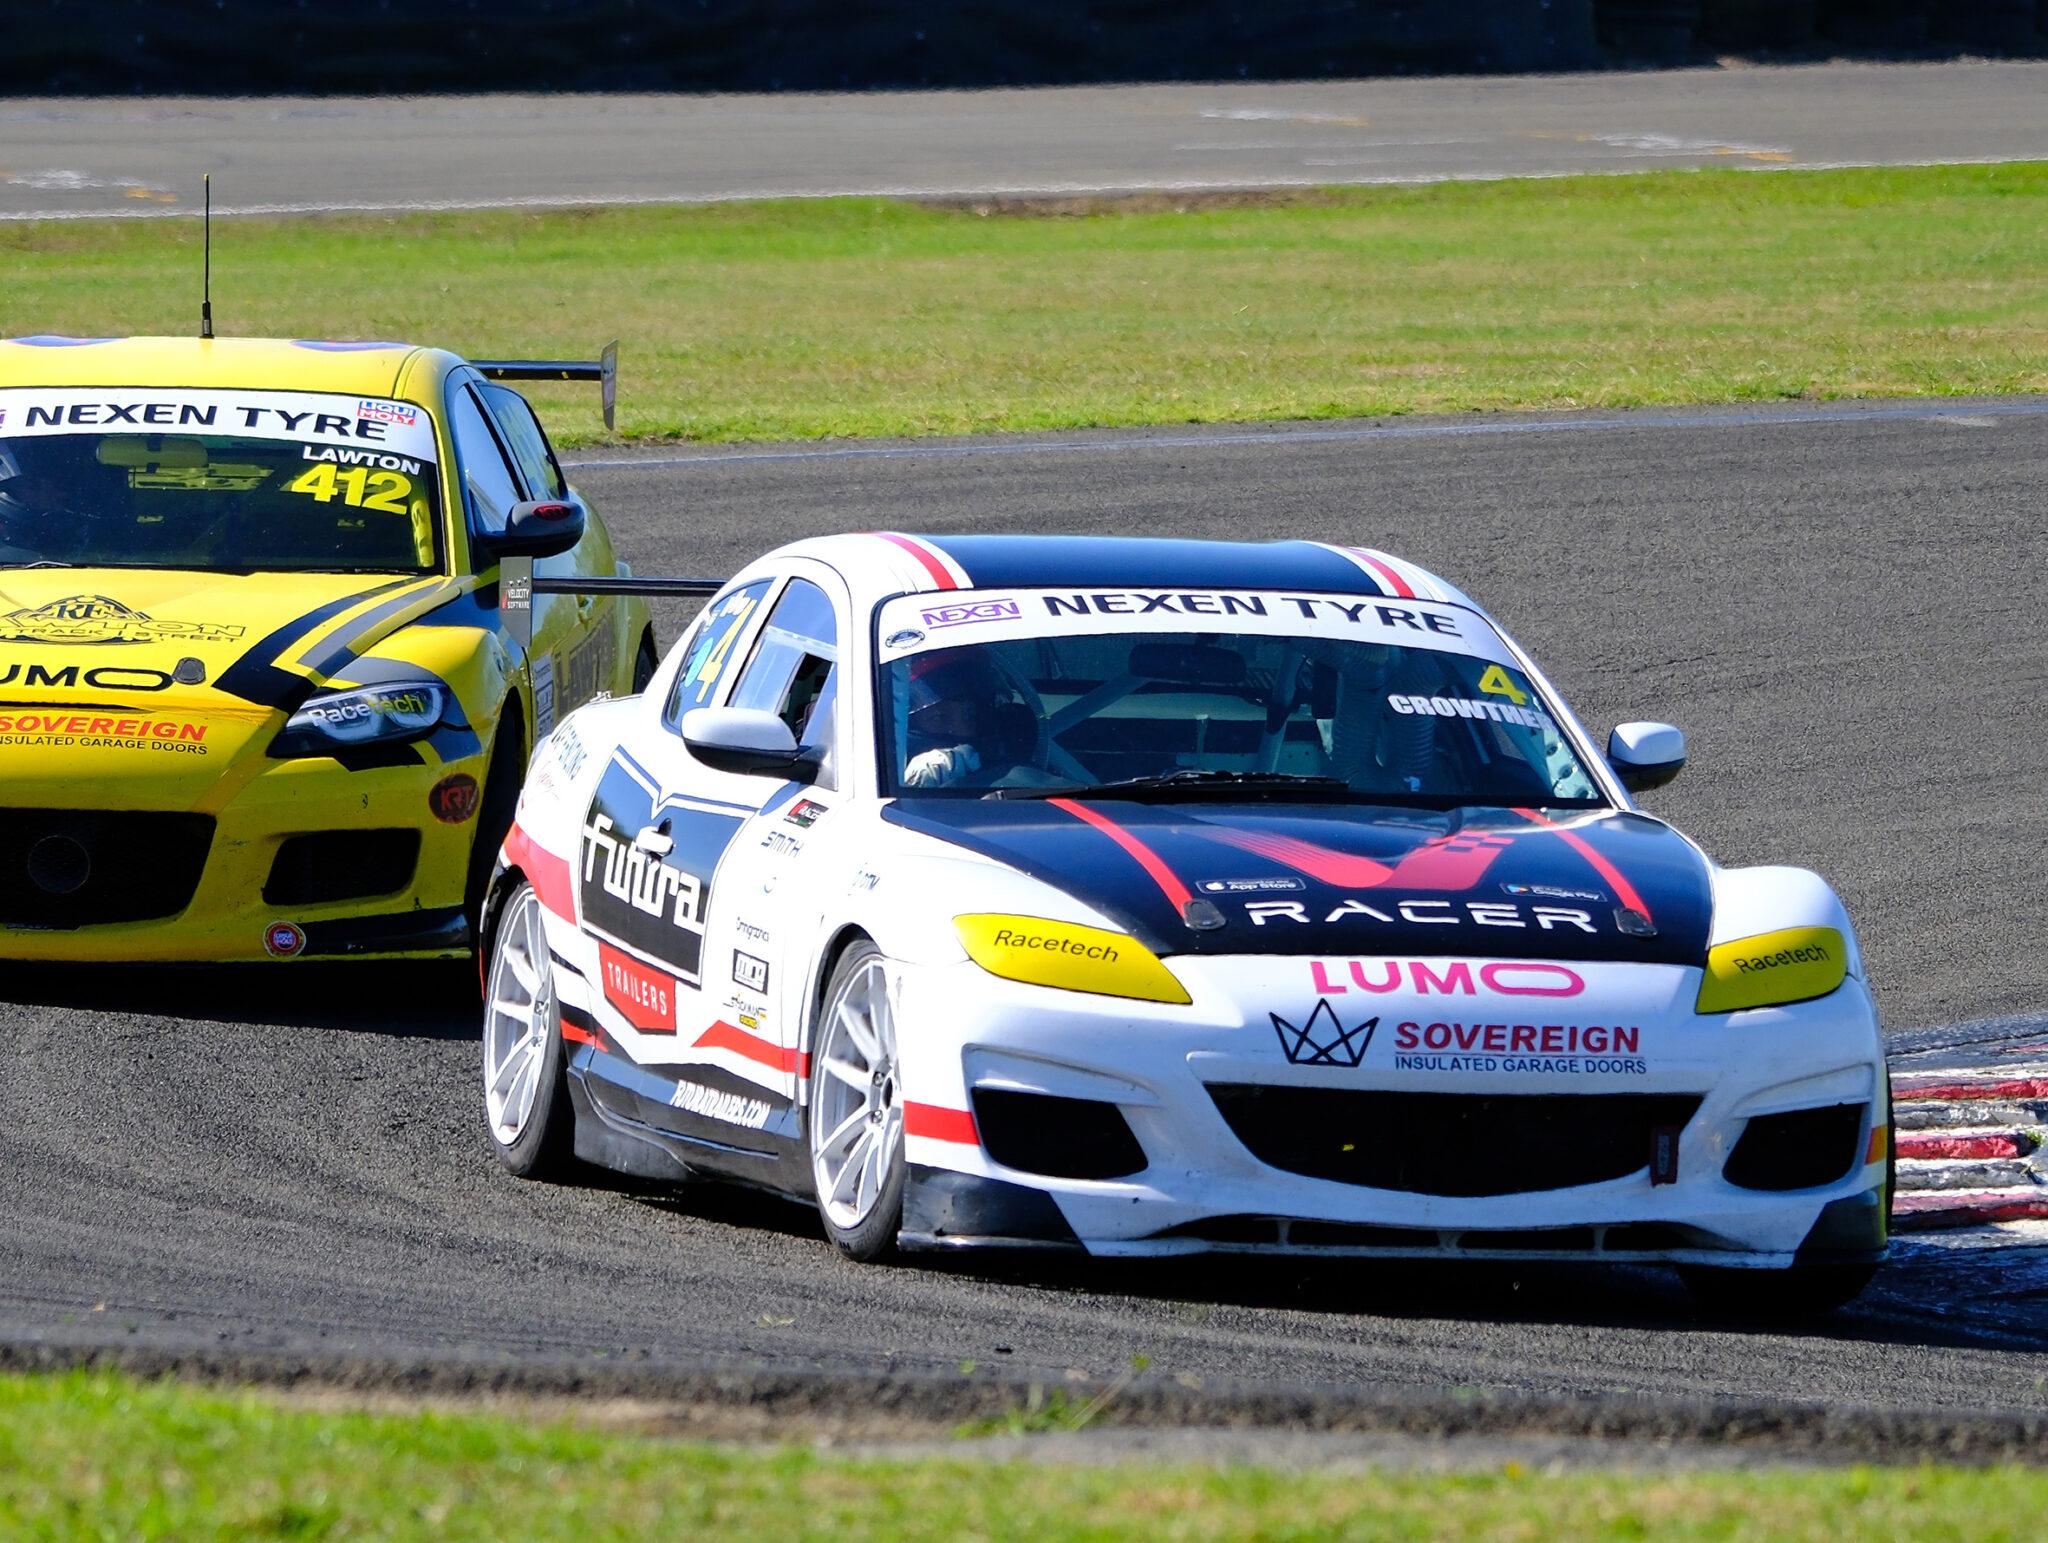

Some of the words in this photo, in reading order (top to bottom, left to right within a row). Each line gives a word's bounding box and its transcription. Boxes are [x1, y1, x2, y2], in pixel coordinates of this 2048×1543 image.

[25, 403, 216, 427] NEXEN
[236, 406, 389, 442] TYRE
[358, 409, 415, 426] MOLY
[360, 401, 416, 418] LIQUI
[303, 446, 421, 476] LAWTON
[291, 464, 412, 515] 412
[922, 602, 1020, 625] NEXEN
[1042, 593, 1267, 616] NEXEN
[1281, 597, 1463, 637] TYRE
[695, 599, 758, 704] 4
[1478, 664, 1527, 705] 4
[308, 694, 425, 727] Racetech
[0, 716, 208, 741] SOVEREIGN
[80, 737, 146, 750] GARAGE
[151, 741, 208, 755] DOORS
[1244, 900, 1598, 933] RACER
[994, 930, 1119, 963] Racetech
[1732, 943, 1831, 975] Racetech
[607, 960, 668, 1016] TRAILERS
[1310, 961, 1586, 997] LUMO
[1394, 1021, 1640, 1053] SOVEREIGN
[1394, 1056, 1497, 1072] INSULATED
[1503, 1057, 1579, 1074] GARAGE
[1585, 1059, 1647, 1075] DOORS
